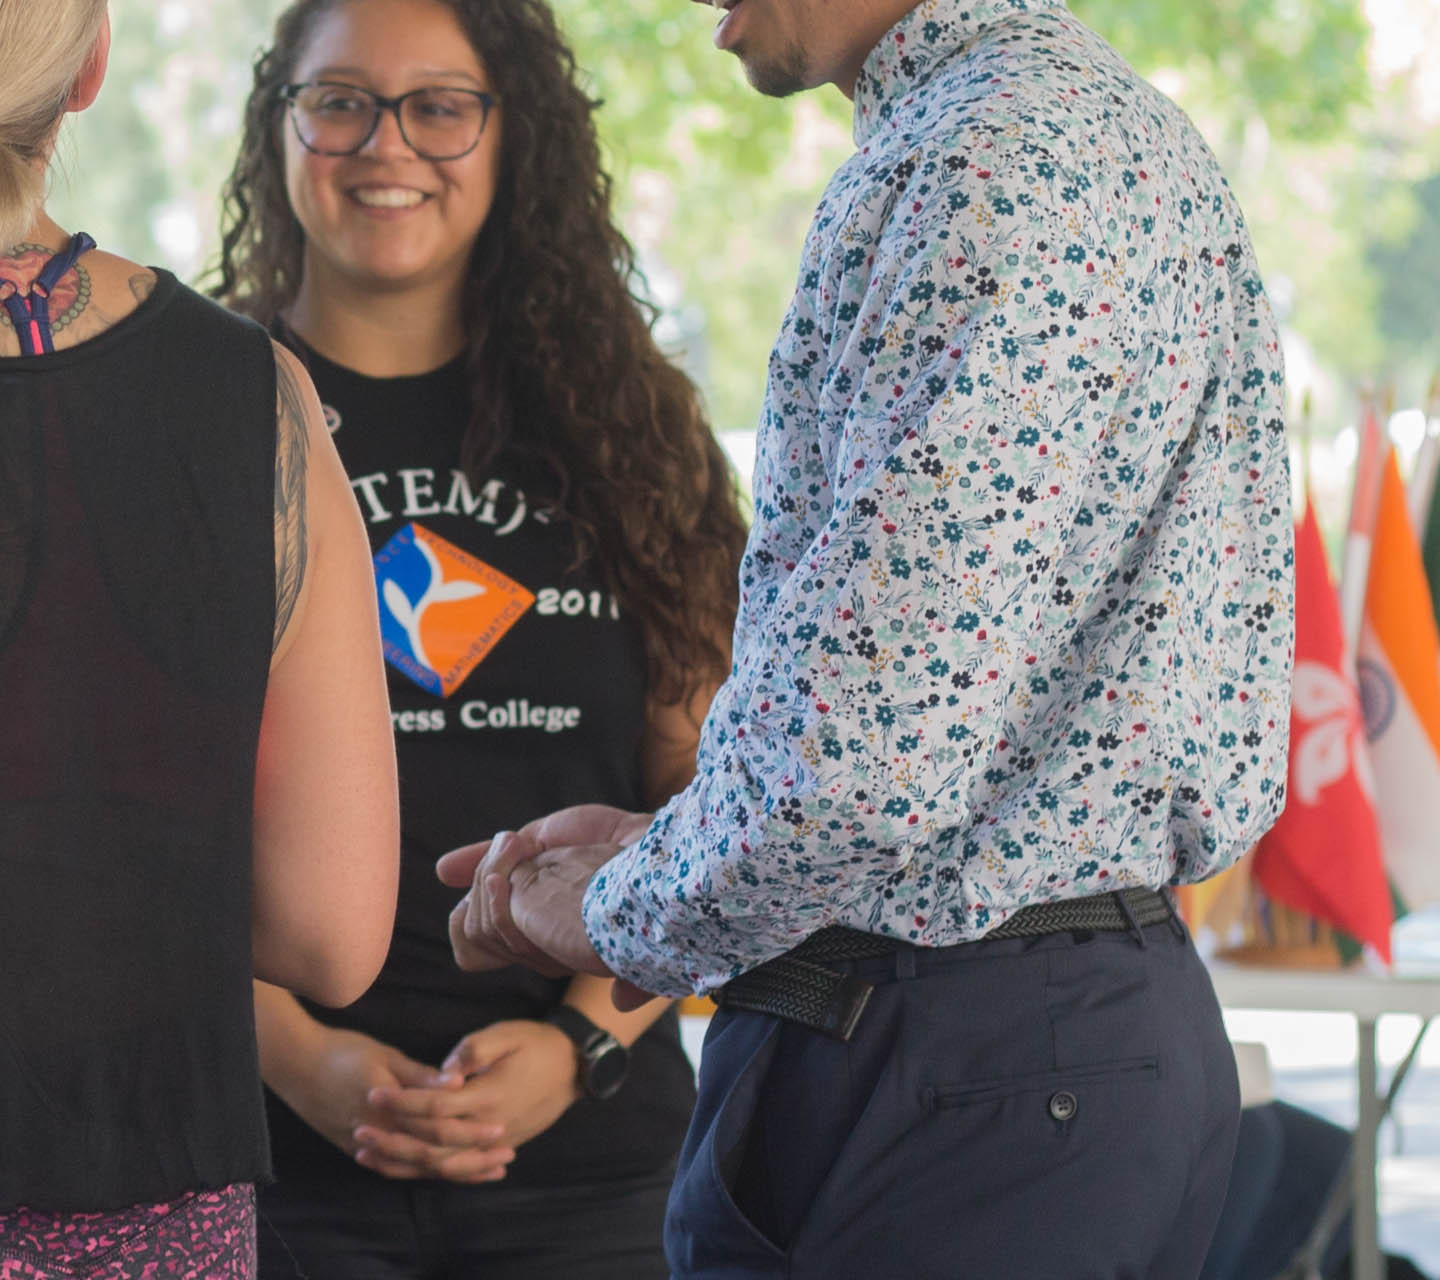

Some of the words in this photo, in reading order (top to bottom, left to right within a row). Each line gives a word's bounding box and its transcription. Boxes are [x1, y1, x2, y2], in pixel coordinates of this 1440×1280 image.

[443, 597, 524, 685] MATHEMATICS
[389, 707, 447, 733] ress
[460, 698, 582, 734] College
